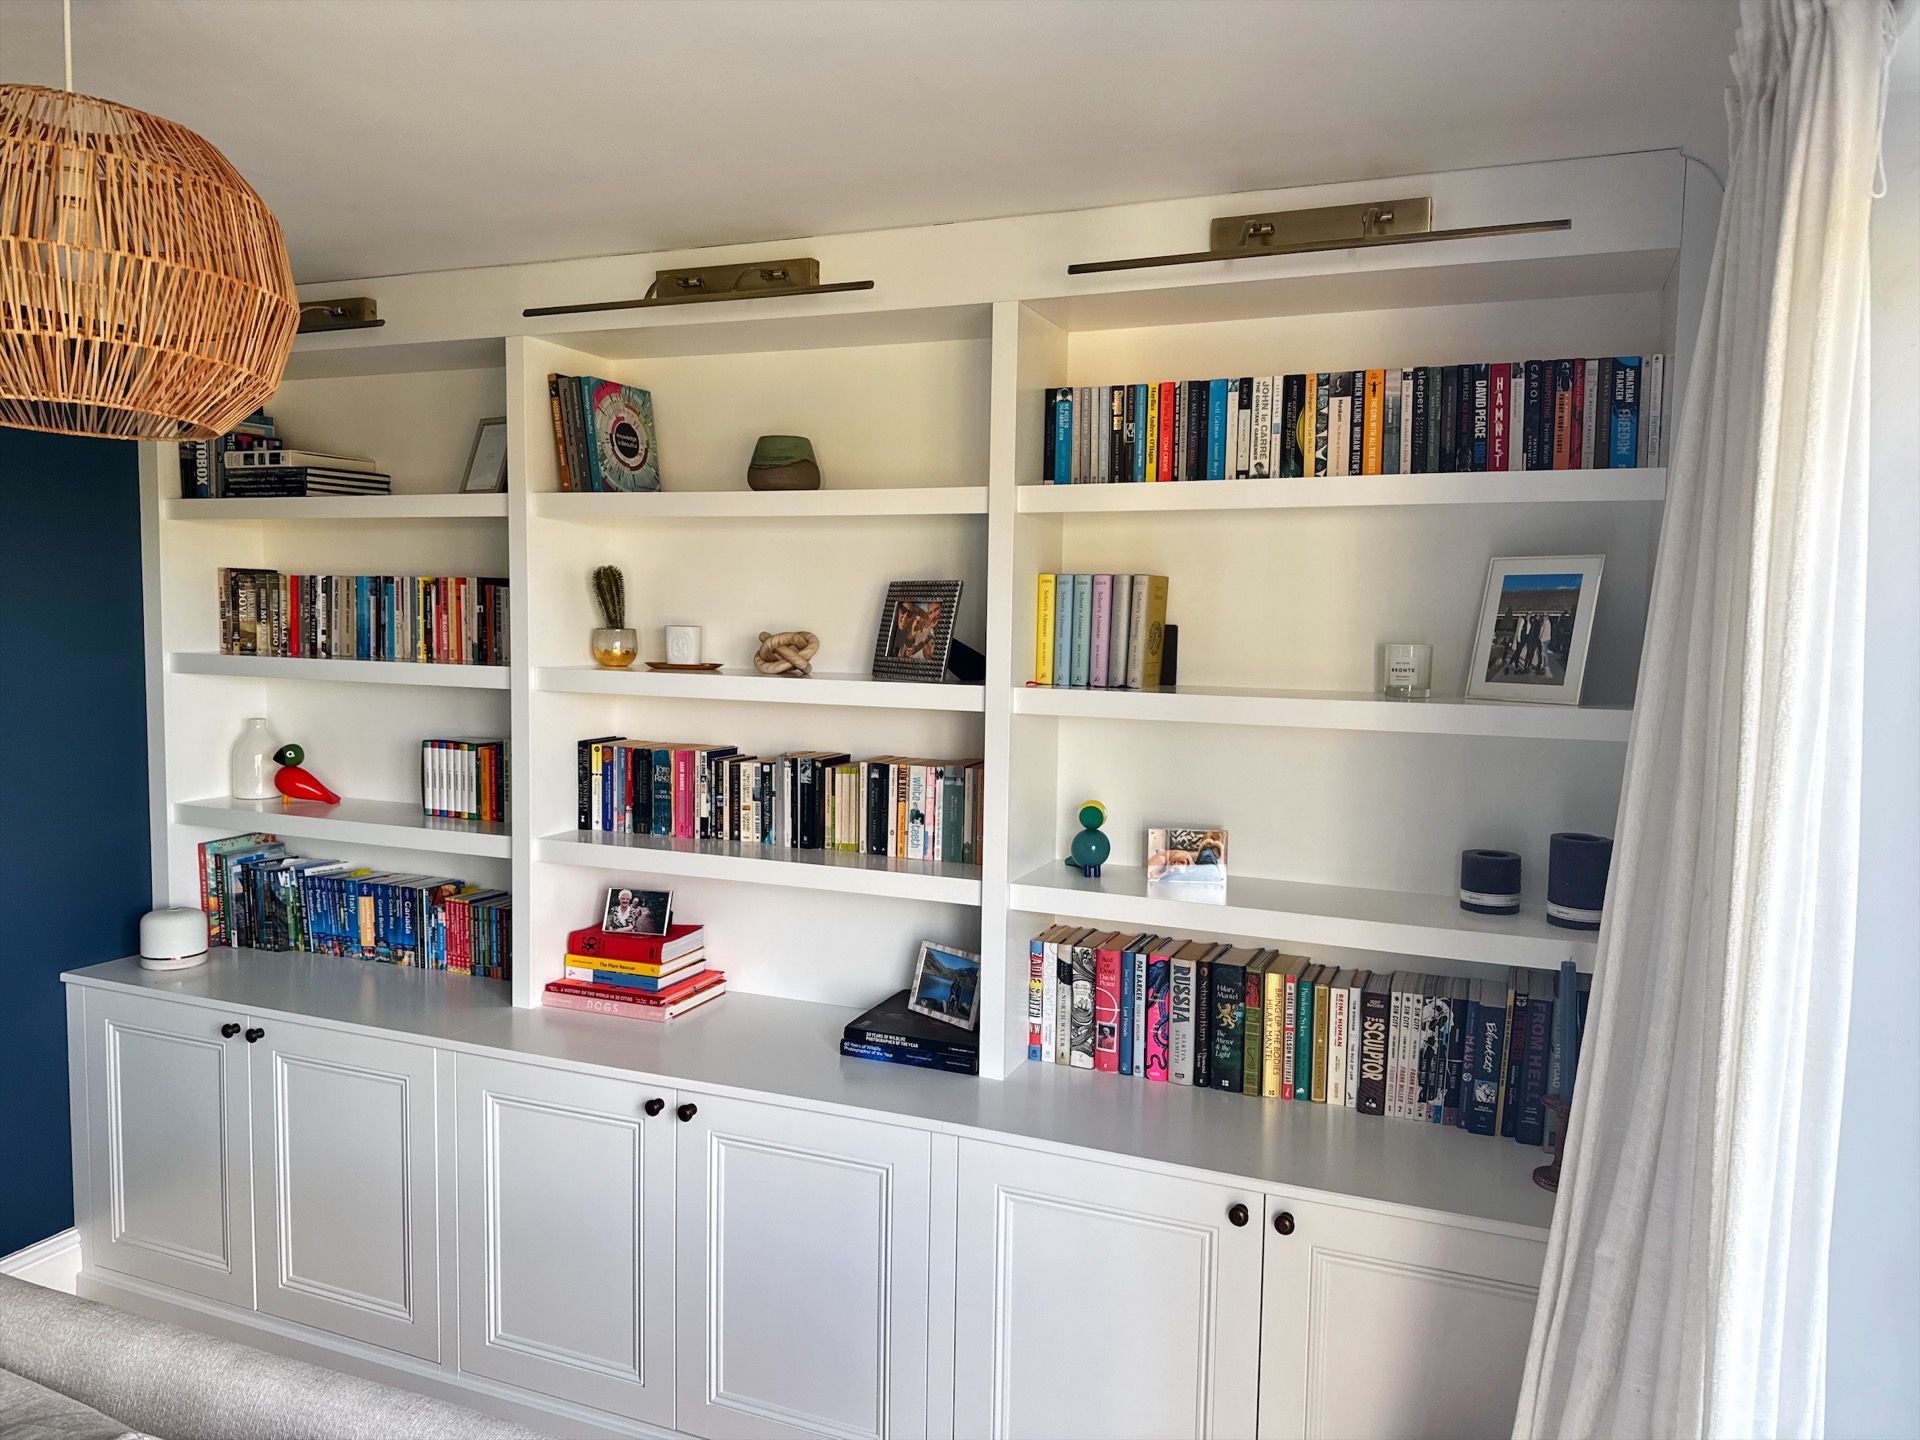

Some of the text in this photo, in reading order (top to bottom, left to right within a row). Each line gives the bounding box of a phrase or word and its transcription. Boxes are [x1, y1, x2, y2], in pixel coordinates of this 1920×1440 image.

[1416, 371, 1426, 414] sleepers
[1462, 368, 1470, 384] DAVID
[1529, 364, 1539, 406] CAROL
[1615, 370, 1625, 401] FRANZEN
[1625, 367, 1635, 403] JONATHAN
[1111, 389, 1124, 431] Shuggie Bain
[1149, 387, 1157, 411] Mayflies
[1475, 380, 1487, 408] DAVID
[1259, 381, 1270, 461] JOHN le CARRÉ
[1351, 372, 1364, 475] WOMEN TALKING MIRIAM TOEWS
[1474, 409, 1486, 439] PEACE
[1542, 366, 1553, 465] TRAINSPOTTING Irvine Welsh
[196, 440, 208, 486] TOBOX
[239, 589, 248, 622] DOVE
[272, 608, 280, 646] LAREDO
[910, 777, 923, 848] white teeth
[217, 883, 225, 918] NATIONAL
[298, 878, 306, 905] Scotland
[308, 889, 316, 921] Scandinavia
[348, 894, 356, 914] Italy
[404, 900, 412, 935] Canada
[1136, 960, 1144, 974] PAT
[1030, 987, 1042, 1019] SMITH
[1135, 974, 1144, 1001] BARKER
[1172, 964, 1191, 1024] RUSSIA
[1216, 984, 1236, 993] Hilary
[1216, 991, 1239, 1000] Mantel
[586, 1000, 619, 1013] DOGS
[1199, 980, 1209, 1043] Sebastian Barry
[1298, 987, 1310, 1037] Pandora Sykes
[1336, 993, 1345, 1048] BEING HUMAN
[1391, 1015, 1399, 1028] CITY
[1392, 1004, 1400, 1015] SIN
[1402, 1017, 1410, 1029] CITY
[1403, 1005, 1411, 1016] SIN
[1059, 1022, 1067, 1048] WATER
[1264, 999, 1274, 1062] HILARY MANTEL
[1272, 988, 1283, 1076] BRING UP THE BODIES
[1284, 992, 1295, 1083] NICKEL BOYS COLSON WHITEHEAD
[1482, 1021, 1499, 1074] Blankets
[1362, 1022, 1385, 1081] SCULPTOR
[1463, 1035, 1475, 1070] MAUS
[1526, 1002, 1547, 1102] FROM HELL
[1552, 1062, 1561, 1088] ROAD
[1398, 1083, 1406, 1103] MILLER
[1408, 1085, 1416, 1105] MILLER
